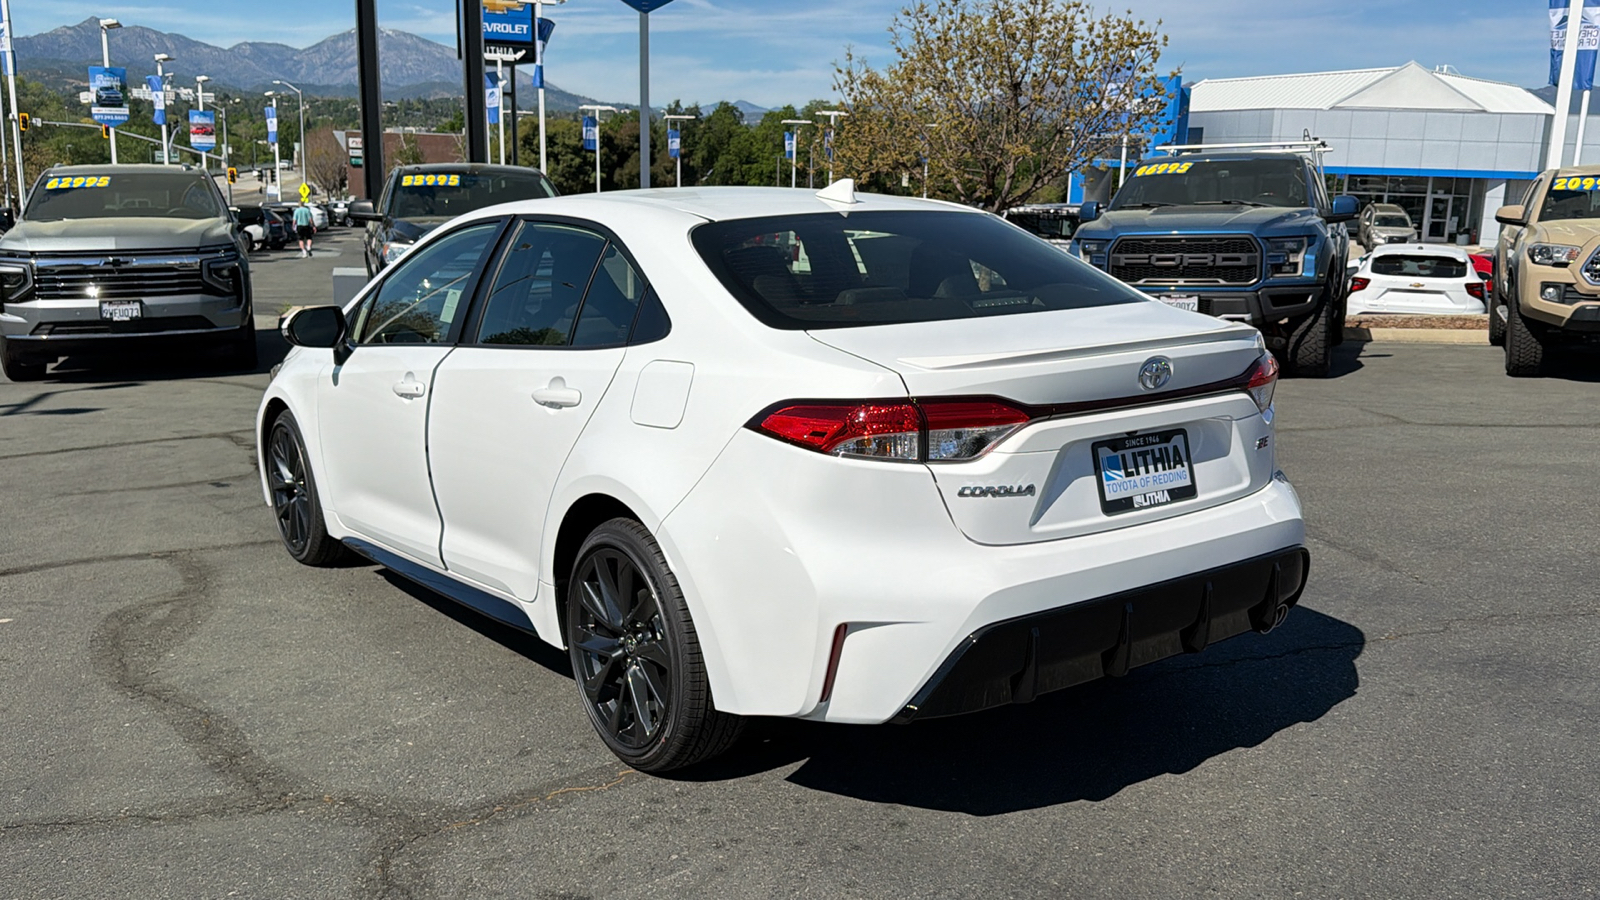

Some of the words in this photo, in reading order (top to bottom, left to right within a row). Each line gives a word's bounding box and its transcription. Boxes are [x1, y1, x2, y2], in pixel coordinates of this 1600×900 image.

[483, 22, 529, 34] EVROLET
[485, 46, 515, 56] ITHIA
[46, 176, 111, 189] 62995
[1553, 177, 1600, 190] 209
[1112, 253, 1250, 267] FORD
[1125, 438, 1144, 448] SINCE
[1145, 435, 1160, 445] 1946
[1120, 444, 1185, 478] LITHIA
[1106, 478, 1139, 494] TOYOTA
[1139, 476, 1151, 488] OF
[1152, 469, 1188, 486] REDDING
[957, 483, 1036, 498] COROLLA
[1142, 489, 1171, 506] LITHIA
